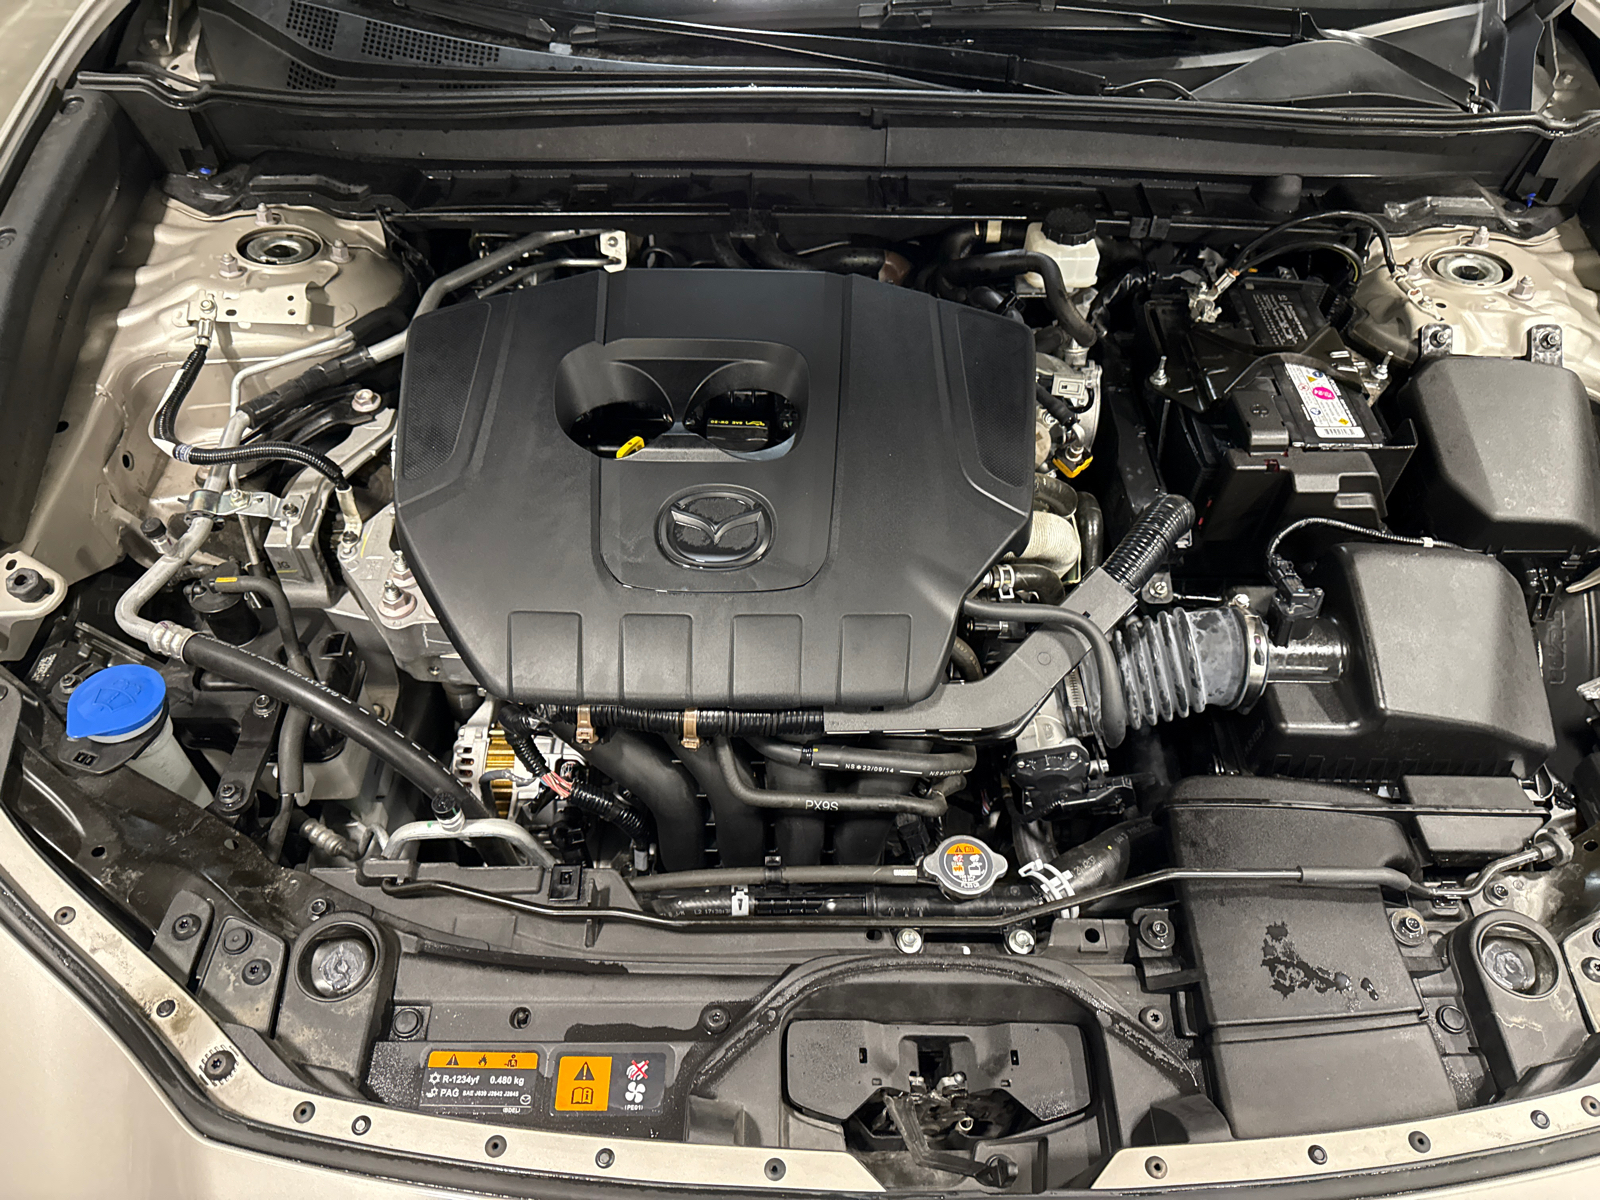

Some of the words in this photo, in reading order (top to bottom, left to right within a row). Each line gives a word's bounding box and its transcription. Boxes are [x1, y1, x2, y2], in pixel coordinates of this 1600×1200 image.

[805, 799, 839, 811] PX9S
[442, 1074, 480, 1086] R-1234yf
[489, 1075, 512, 1085] 0.480
[513, 1075, 525, 1087] kg
[439, 1087, 460, 1097] PAG
